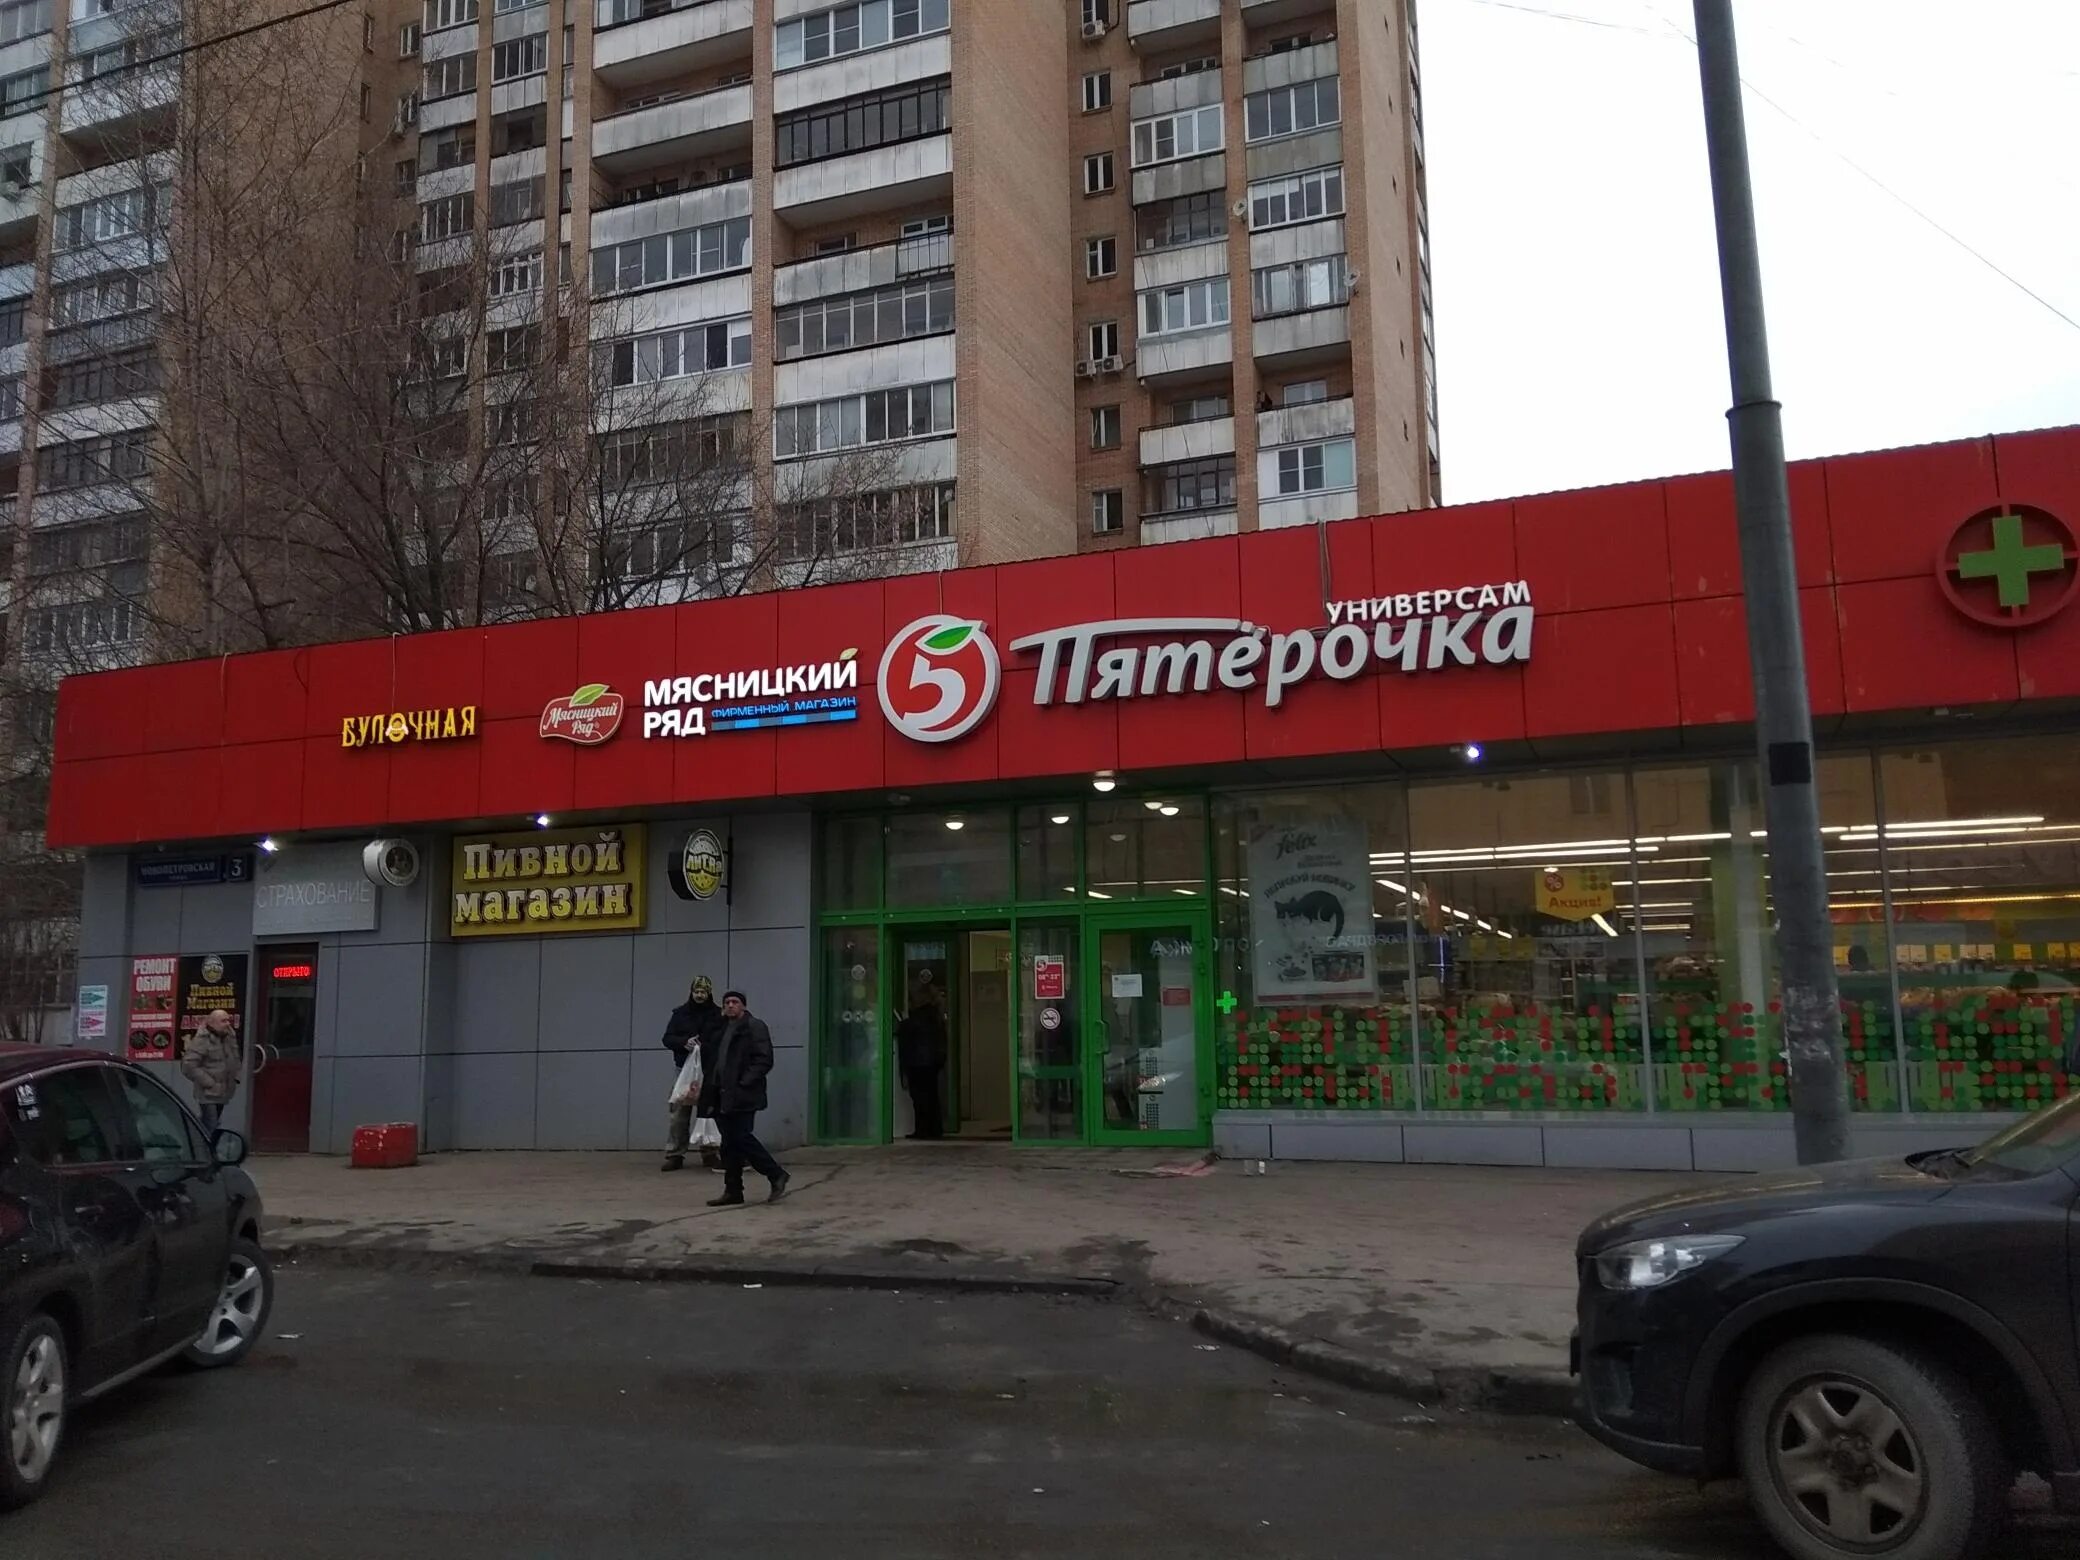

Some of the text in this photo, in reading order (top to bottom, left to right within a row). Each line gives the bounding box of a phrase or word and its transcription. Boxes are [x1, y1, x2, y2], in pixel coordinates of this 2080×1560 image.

[1327, 580, 1531, 624] УНИВЕРСАМ
[644, 652, 857, 707] МЯСНИЦКИЙ
[543, 701, 618, 730] Мясницкий
[711, 696, 857, 718] ФИРМЕННЫЙ МАГАЗИН
[341, 705, 477, 748] БУЛОЧНАЯ
[644, 707, 706, 739] РЯД
[231, 858, 242, 877] 3
[463, 832, 624, 882] Пивной
[256, 880, 371, 909] СТРАХОВАНИЕ
[454, 882, 632, 926] магазин
[133, 958, 177, 975] РЕМОНТ
[136, 975, 172, 992] ОБУВИ
